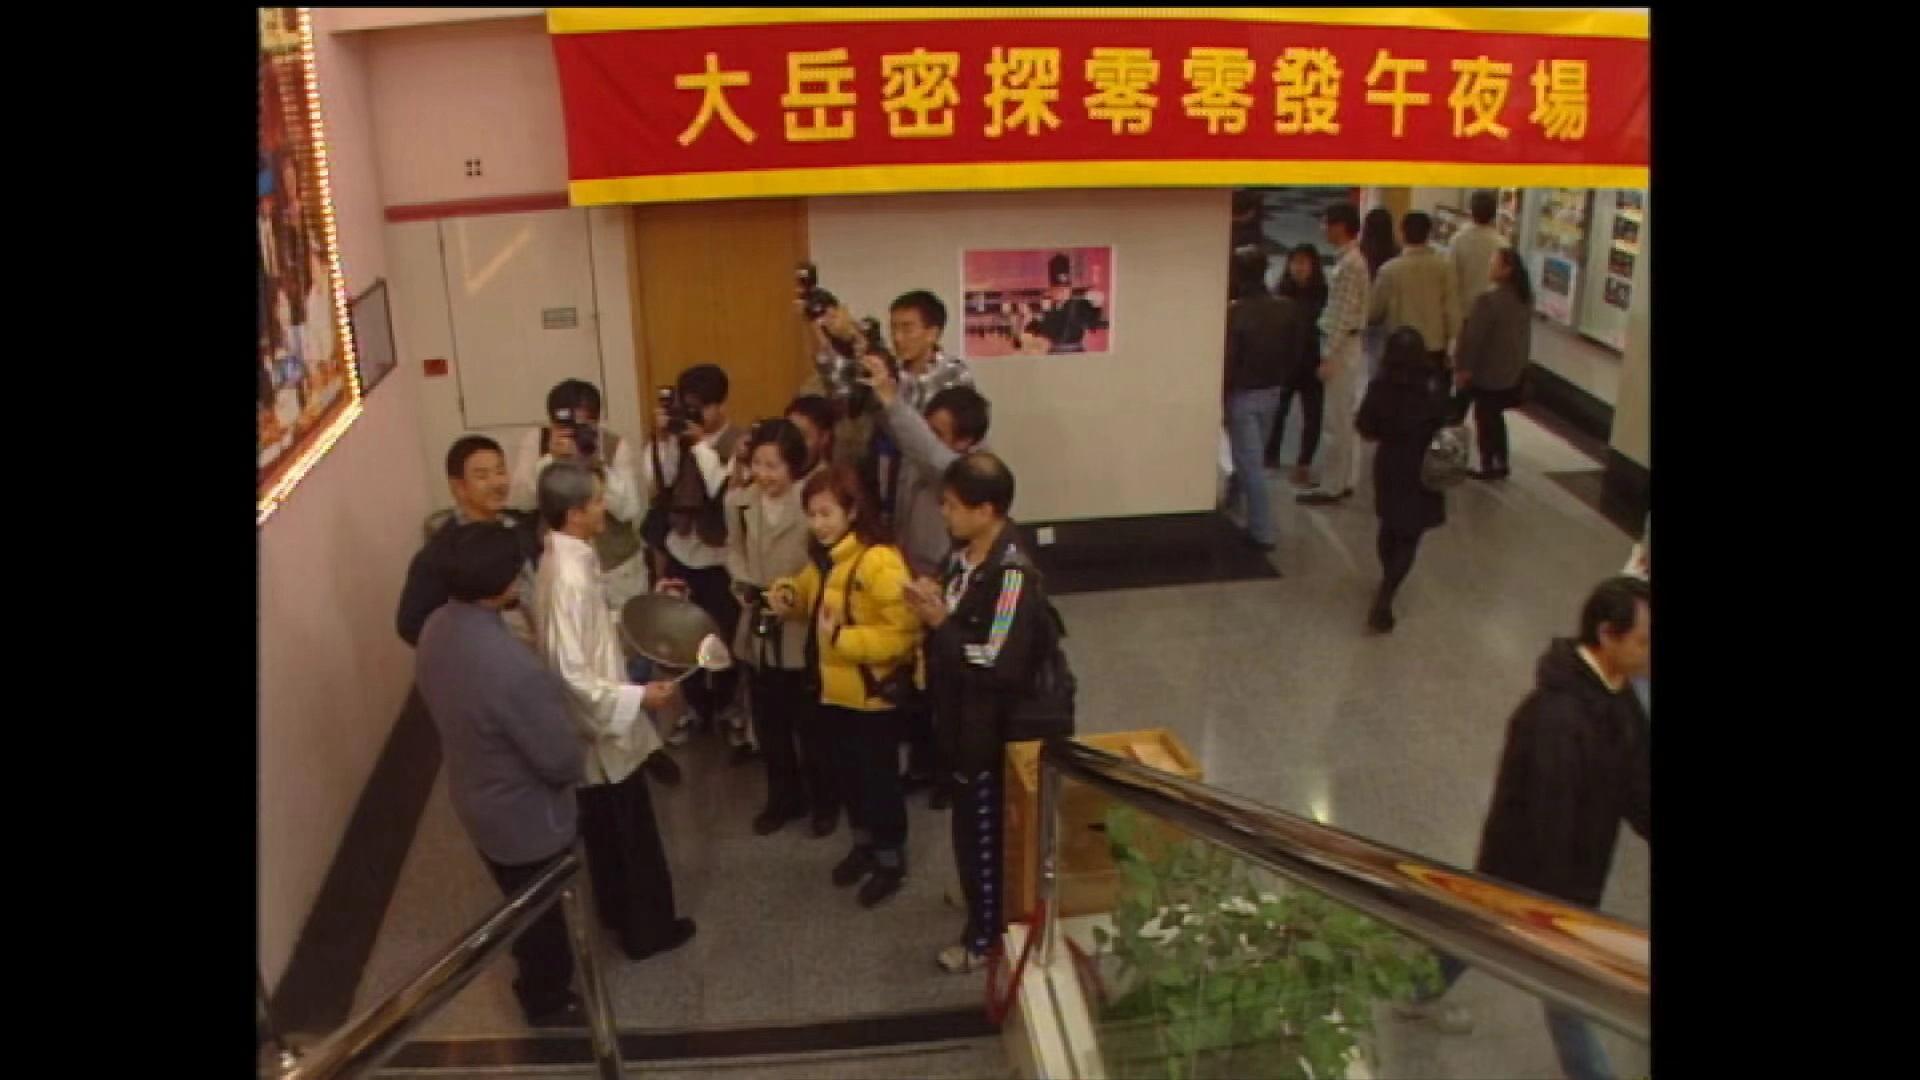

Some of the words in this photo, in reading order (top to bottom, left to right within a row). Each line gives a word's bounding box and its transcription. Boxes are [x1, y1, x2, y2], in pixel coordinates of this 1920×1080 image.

[676, 46, 1589, 146] 大岳密探零零發午夜場
